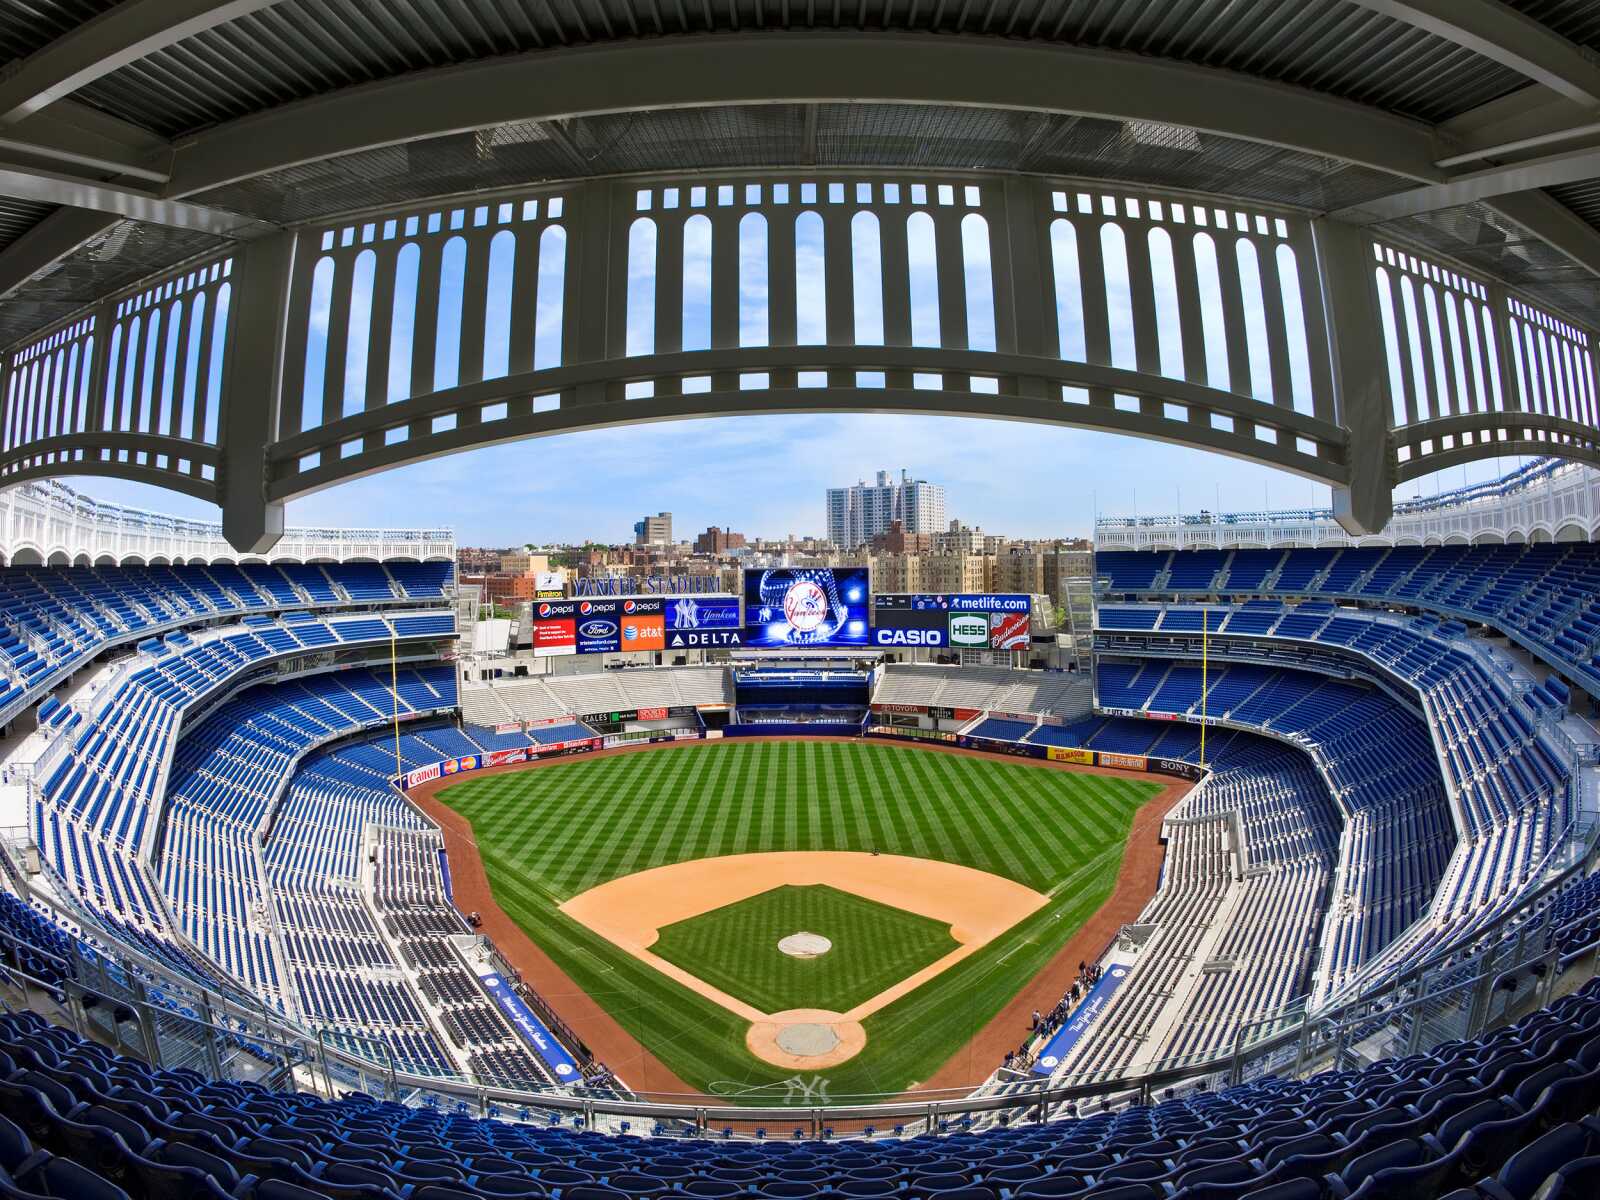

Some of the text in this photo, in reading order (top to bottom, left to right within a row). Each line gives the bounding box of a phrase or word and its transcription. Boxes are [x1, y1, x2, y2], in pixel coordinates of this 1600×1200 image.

[647, 574, 720, 595] STADIUM
[551, 604, 574, 615] pepsi
[593, 602, 616, 613] pepsi
[636, 601, 660, 611] pepsi
[961, 597, 1027, 610] metlife.com
[702, 608, 736, 624] Yankees
[587, 623, 609, 635] Ford
[639, 626, 662, 638] at&t
[953, 624, 986, 636] HESS
[689, 633, 741, 644] DELTA
[877, 629, 942, 645] CASIO
[891, 705, 918, 713] TOYOTA
[585, 713, 608, 723] ZALES
[1160, 760, 1190, 773] SONY
[409, 766, 439, 785] Canon
